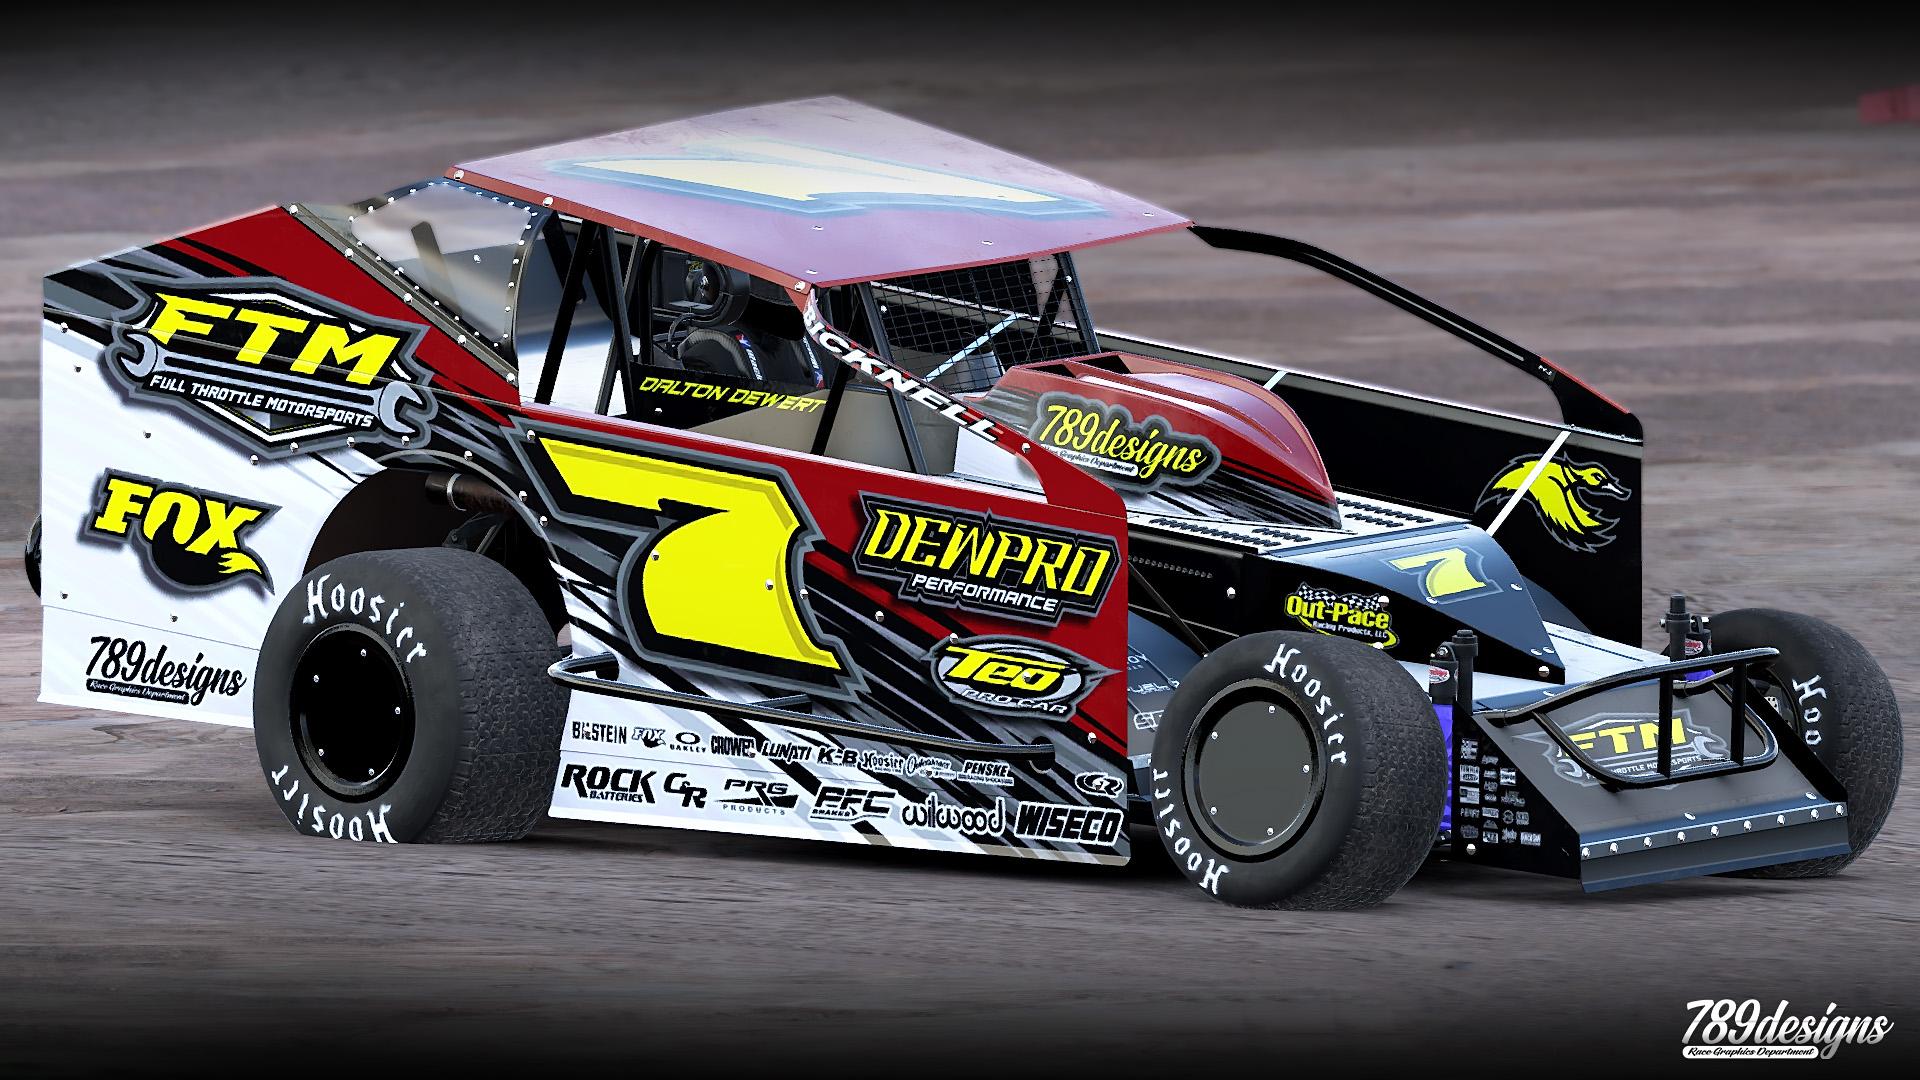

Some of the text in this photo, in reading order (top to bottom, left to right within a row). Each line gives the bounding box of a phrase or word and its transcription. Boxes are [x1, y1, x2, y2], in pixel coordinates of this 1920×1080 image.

[148, 293, 400, 385] FTM
[803, 301, 1000, 443] BICKNELL
[150, 375, 375, 428] FULL THROTTLE MOTORSPORTS
[639, 377, 829, 413] DALTON DEWERT
[1038, 405, 1208, 479] 789designs
[94, 477, 263, 556] FOX
[539, 437, 842, 670] 7
[864, 508, 1111, 597] DEWPRO
[1388, 547, 1487, 598] 7
[911, 573, 1059, 612] PERFORMANCE
[1286, 595, 1390, 630] Out-Pace
[302, 573, 427, 663] Hoosier
[1312, 620, 1337, 632] Racing
[1374, 630, 1388, 639] LLC
[85, 635, 248, 707] 789designs
[961, 688, 1069, 713] PRO CAR
[1263, 643, 1347, 765] Hoosier
[631, 726, 666, 742] FOX
[669, 743, 707, 753] OAKLEY
[761, 742, 812, 763] LUNATI
[862, 751, 904, 769] Hoosier
[963, 761, 1009, 777] PENSKE
[561, 763, 657, 804] ROCK
[589, 790, 644, 803] BATTERIES
[723, 778, 789, 806] PRG
[814, 786, 897, 814] PFC
[271, 764, 399, 845] Hoosier
[722, 804, 786, 816] PRODUCTS
[812, 808, 851, 817] BRAKES
[902, 793, 1006, 835] wilwood
[1014, 804, 1123, 844] WISECO
[1152, 767, 1231, 895] Hoosier
